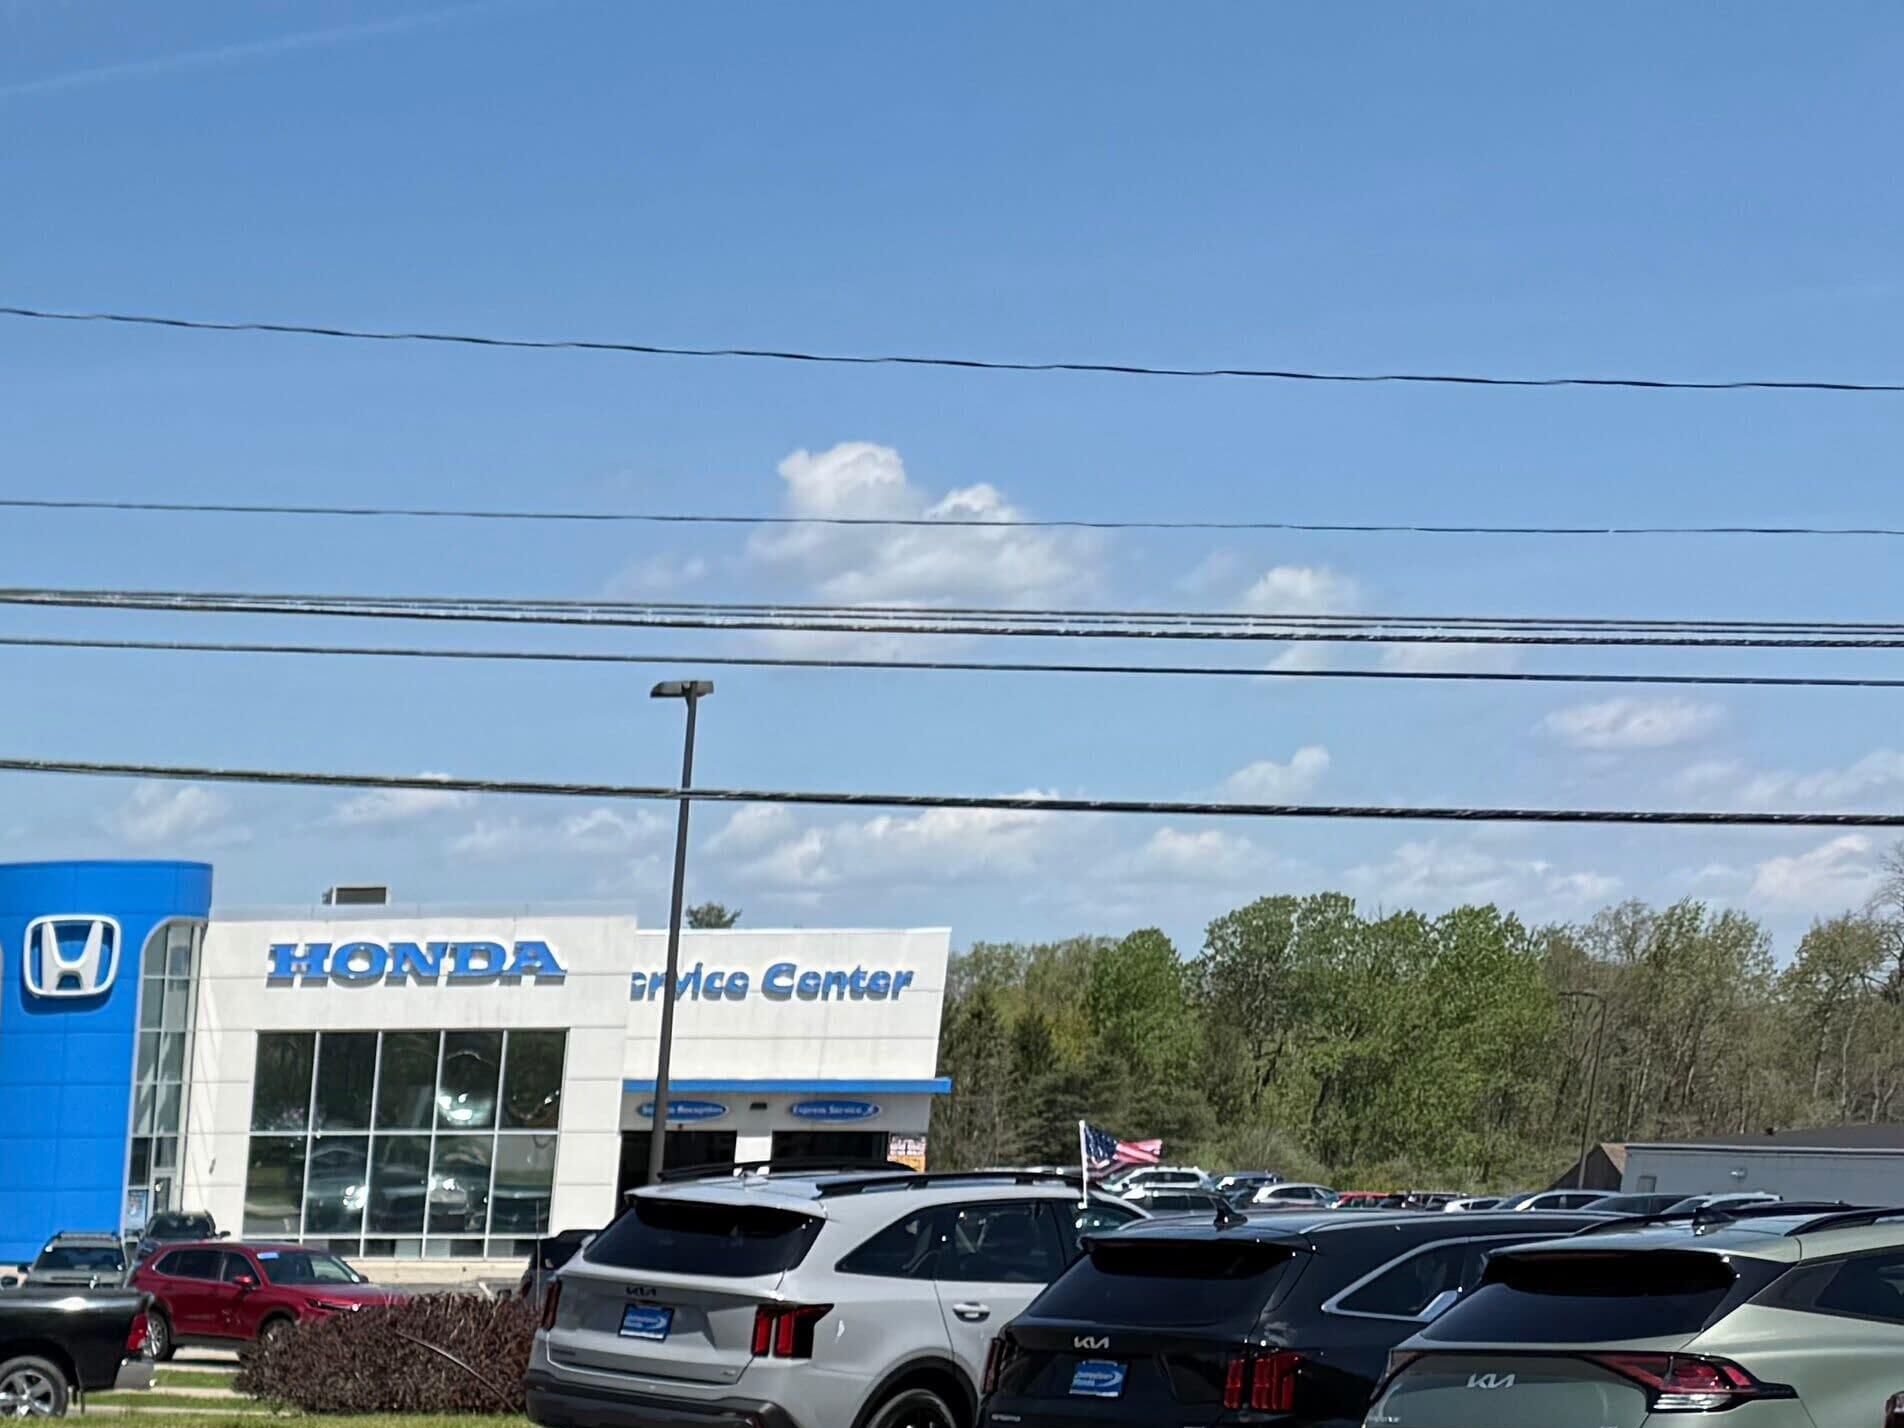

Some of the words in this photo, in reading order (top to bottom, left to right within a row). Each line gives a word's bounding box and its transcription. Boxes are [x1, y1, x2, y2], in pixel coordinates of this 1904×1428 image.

[268, 940, 566, 982] HONDA
[630, 962, 750, 997] ervice
[760, 962, 914, 997] Center
[1466, 1373, 1517, 1389] KIA
